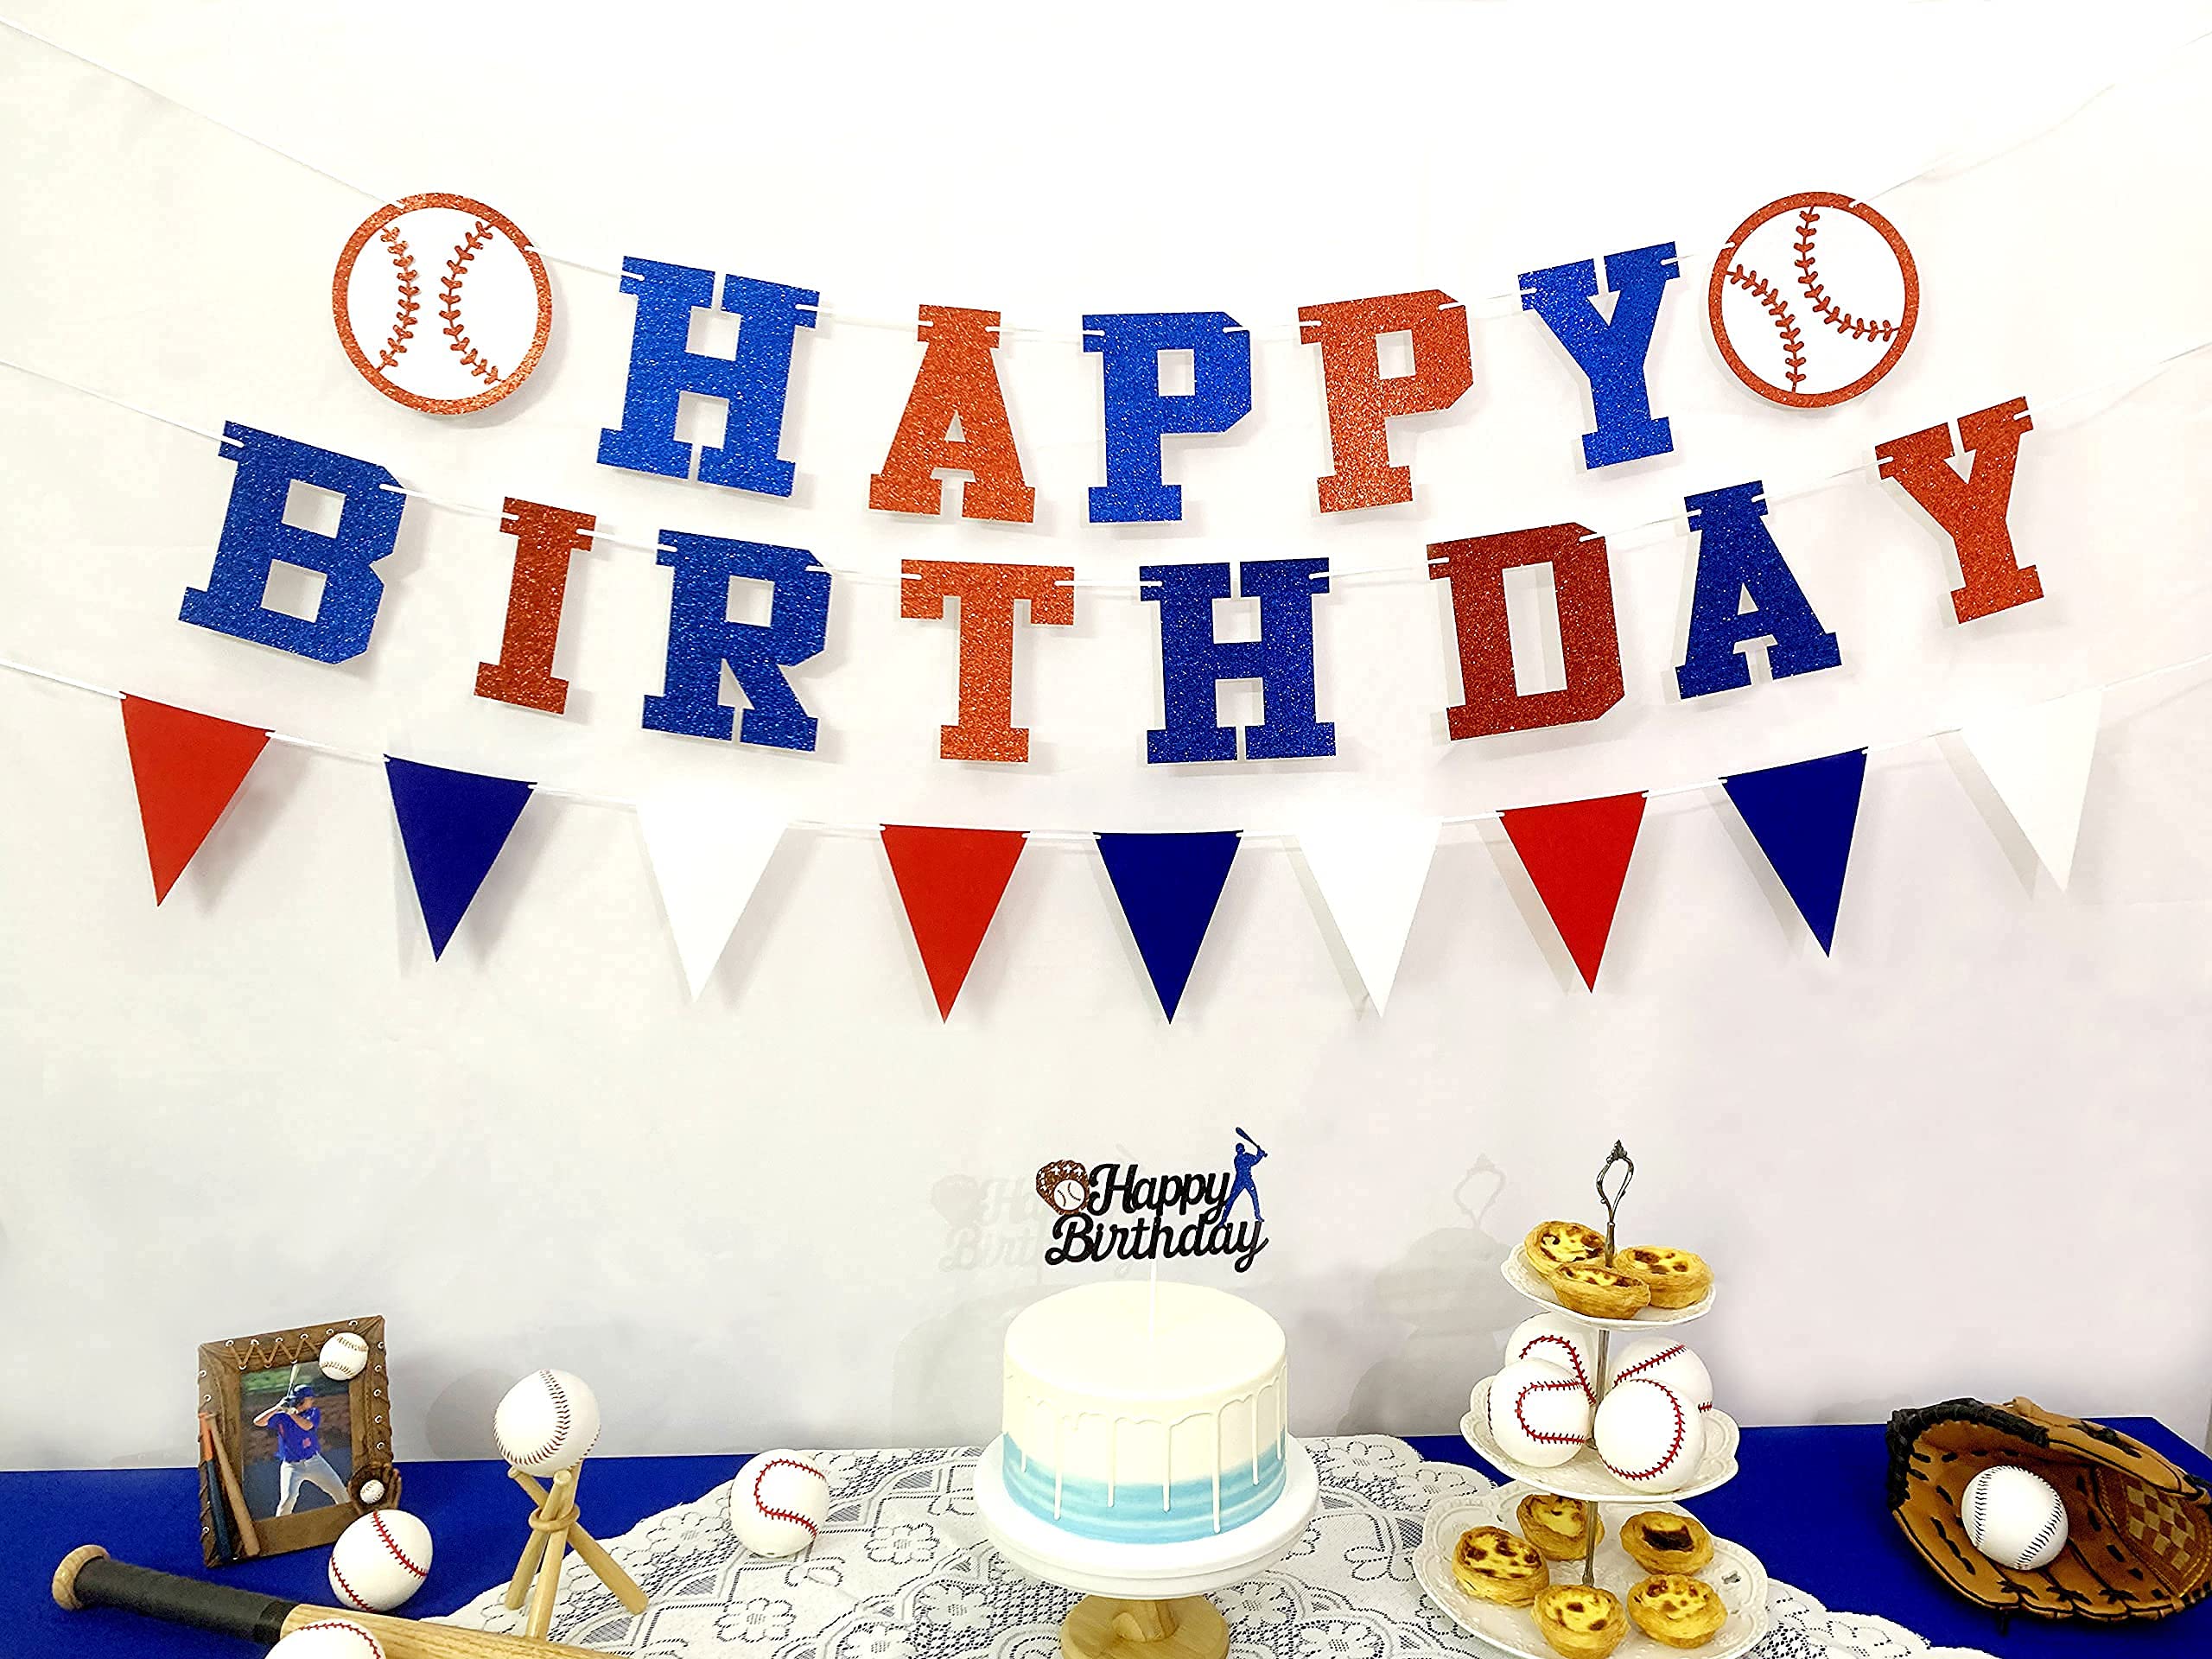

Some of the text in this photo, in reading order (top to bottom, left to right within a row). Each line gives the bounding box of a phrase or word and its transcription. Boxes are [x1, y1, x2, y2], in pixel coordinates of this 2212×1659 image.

[597, 242, 1680, 523] HAPPY
[179, 397, 2044, 764] BIRTHDAY
[1045, 1211, 1269, 1273] Birthday
[1089, 1163, 1230, 1225] Happy
